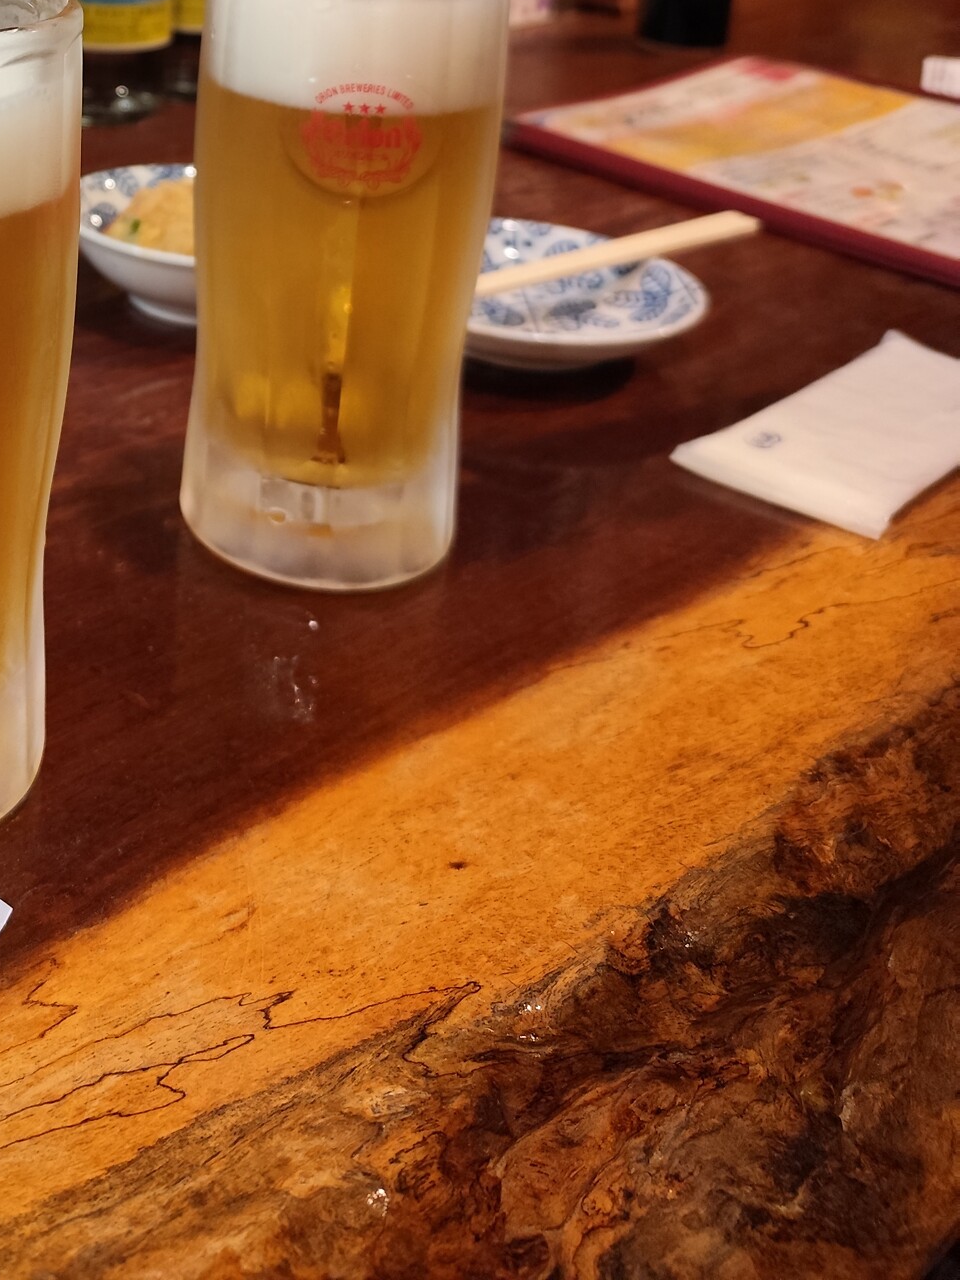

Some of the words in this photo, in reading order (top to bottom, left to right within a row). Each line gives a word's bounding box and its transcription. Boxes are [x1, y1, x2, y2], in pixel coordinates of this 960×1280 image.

[315, 86, 339, 104] ORION
[340, 83, 386, 96] BREWERIES
[387, 88, 415, 110] LIMITED
